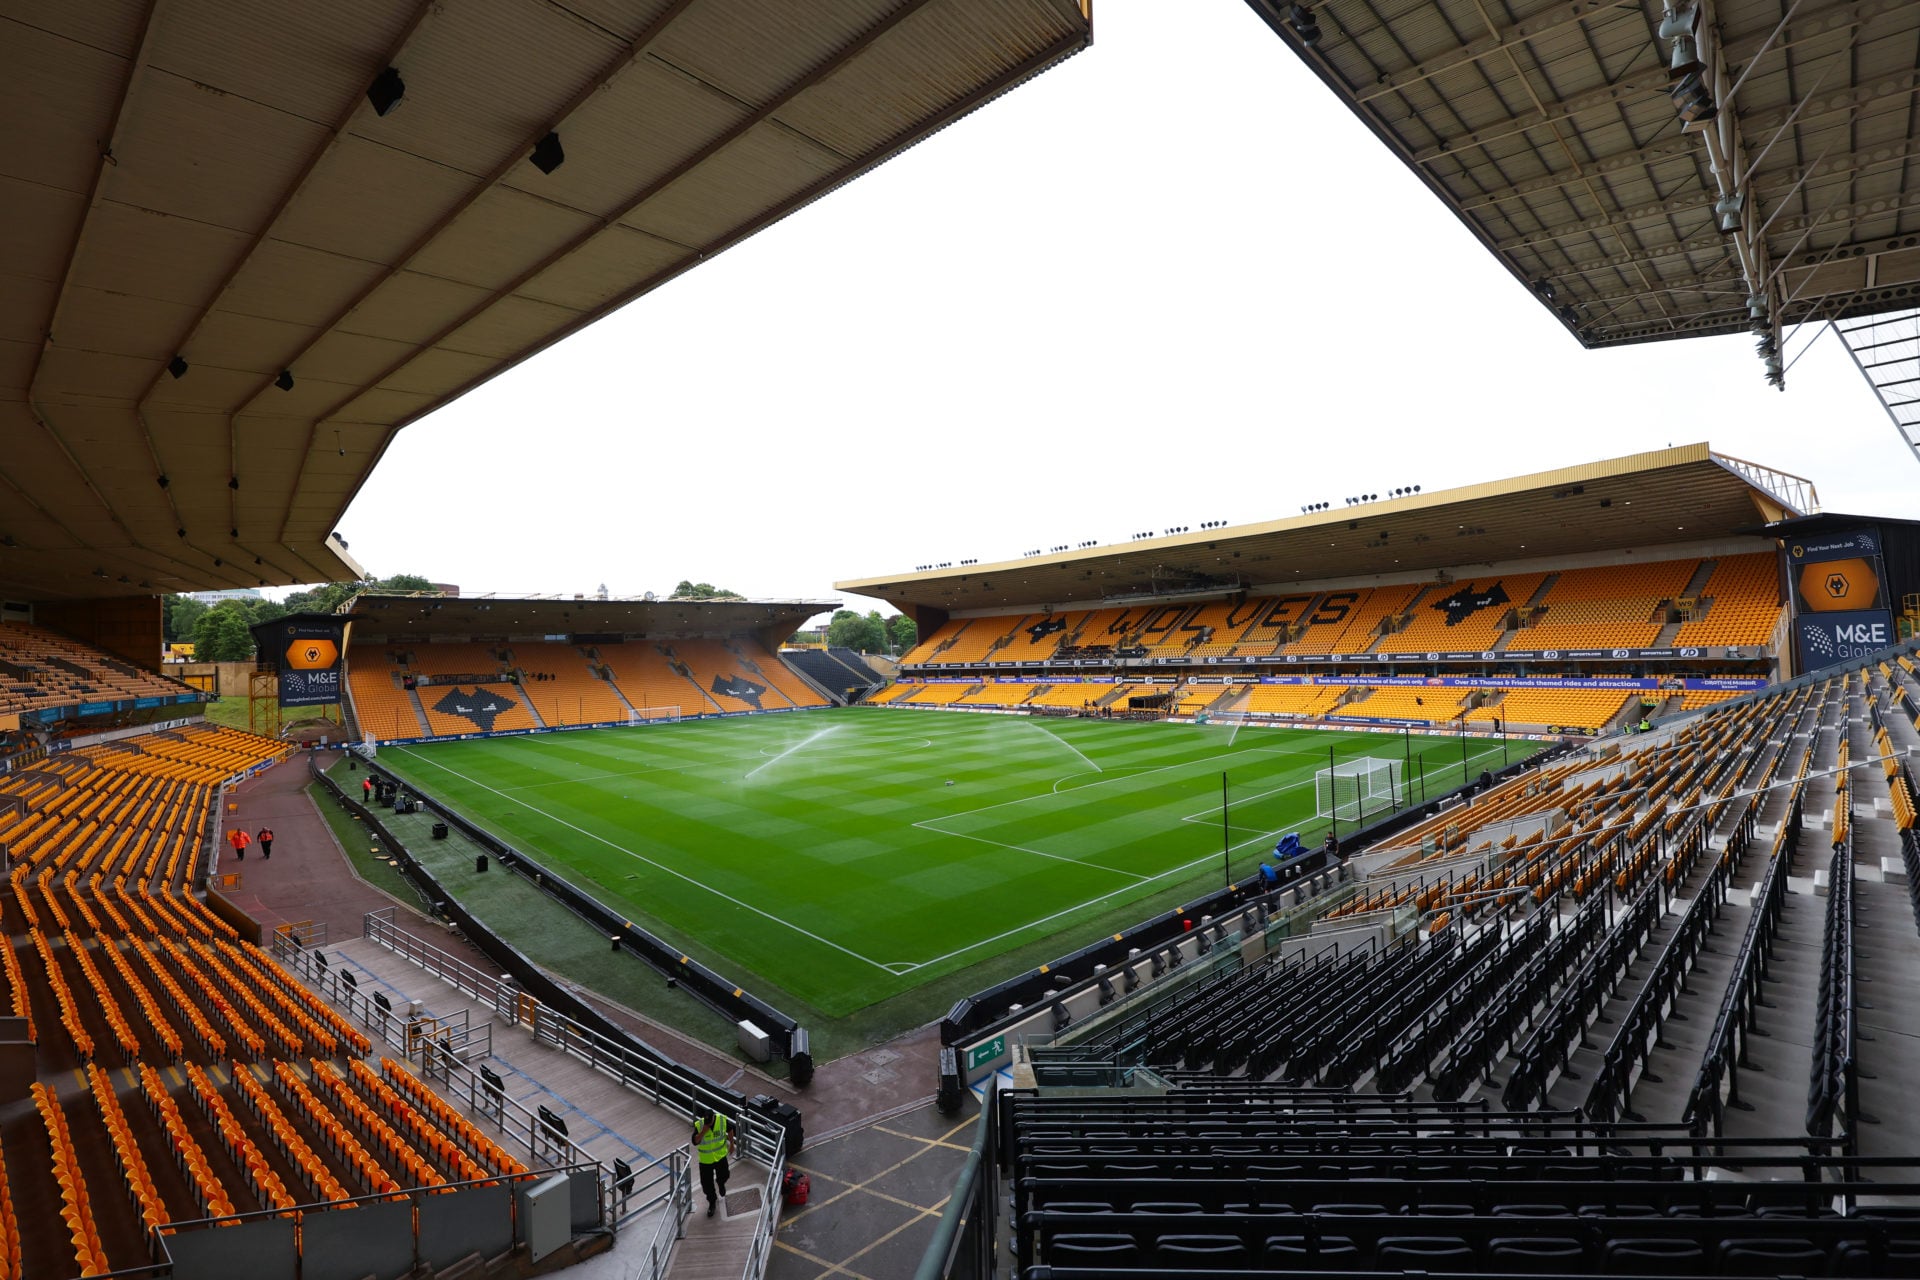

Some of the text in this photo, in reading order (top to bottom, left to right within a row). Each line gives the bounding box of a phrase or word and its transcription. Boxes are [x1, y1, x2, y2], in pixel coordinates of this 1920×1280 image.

[1108, 592, 1360, 635] WOLVES
[1836, 623, 1886, 643] M&E
[308, 672, 337, 684] M&E
[308, 684, 338, 693] Global
